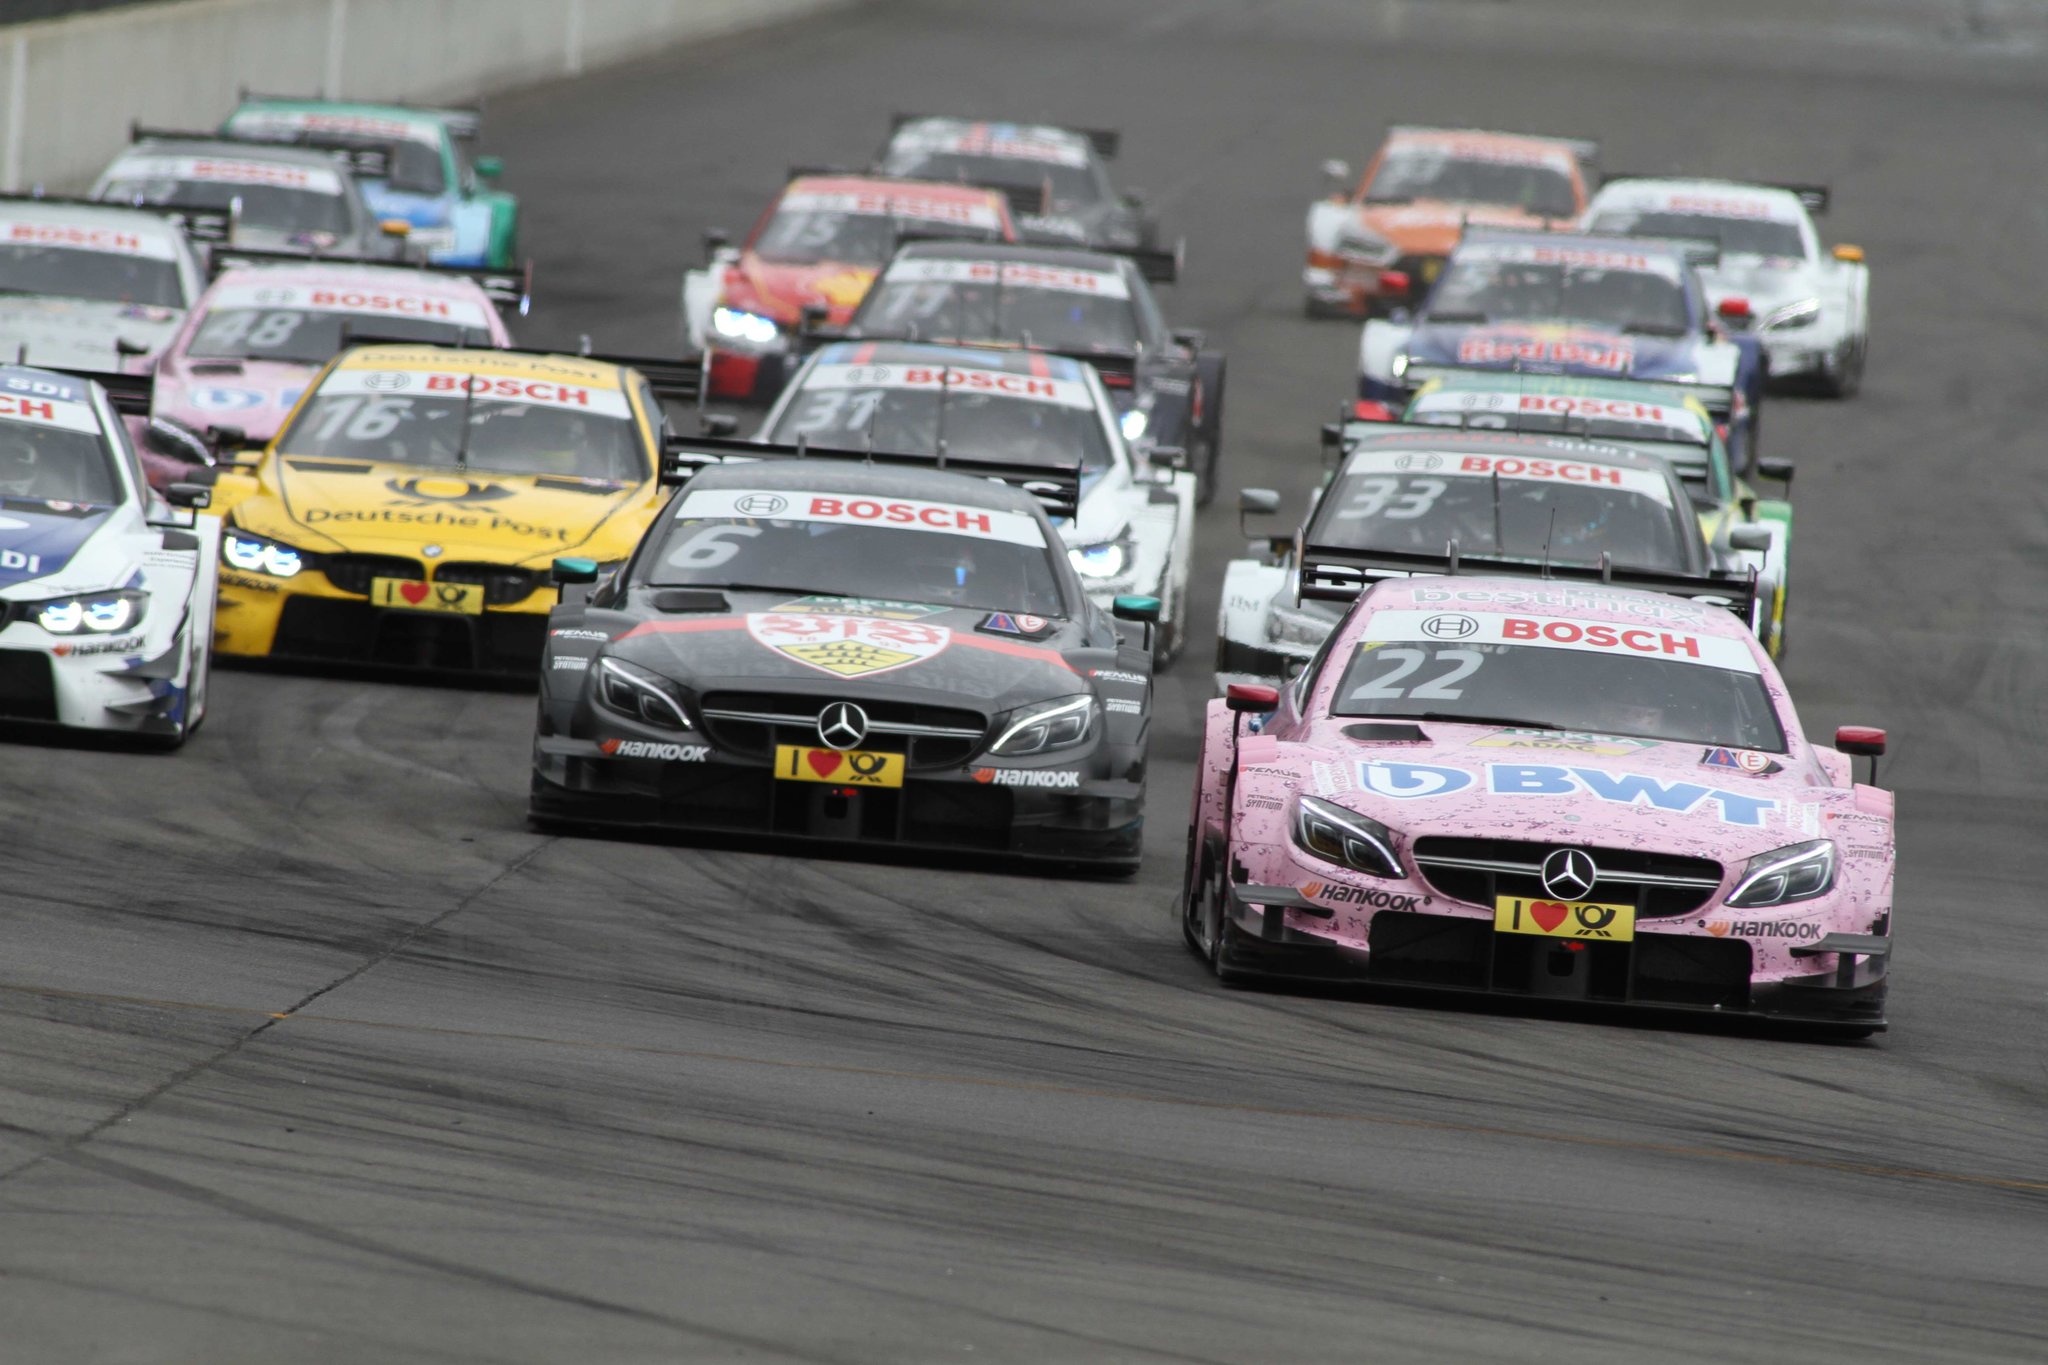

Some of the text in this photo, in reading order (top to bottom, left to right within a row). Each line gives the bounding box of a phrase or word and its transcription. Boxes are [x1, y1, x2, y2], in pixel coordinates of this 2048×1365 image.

[309, 290, 450, 317] BOSCH
[204, 310, 301, 347] 48
[6, 377, 71, 399] SDI
[425, 374, 589, 406] BOSCH
[904, 369, 1056, 398] BOSCH
[313, 398, 415, 442] 16
[795, 389, 886, 432] 31
[1519, 396, 1663, 421] BOSCH
[1460, 455, 1622, 485] BOSCH
[809, 498, 991, 533] BOSCH
[1336, 478, 1448, 520] 33
[305, 507, 569, 543] Deutsche Post
[667, 523, 764, 569] 6
[1502, 618, 1700, 658] BOSCH
[1349, 648, 1485, 701] 22
[791, 750, 799, 776] I
[1245, 766, 1302, 779] REMUS
[1490, 765, 1777, 827] BWT
[1833, 813, 1889, 825] REMUS
[1512, 900, 1521, 931] I
